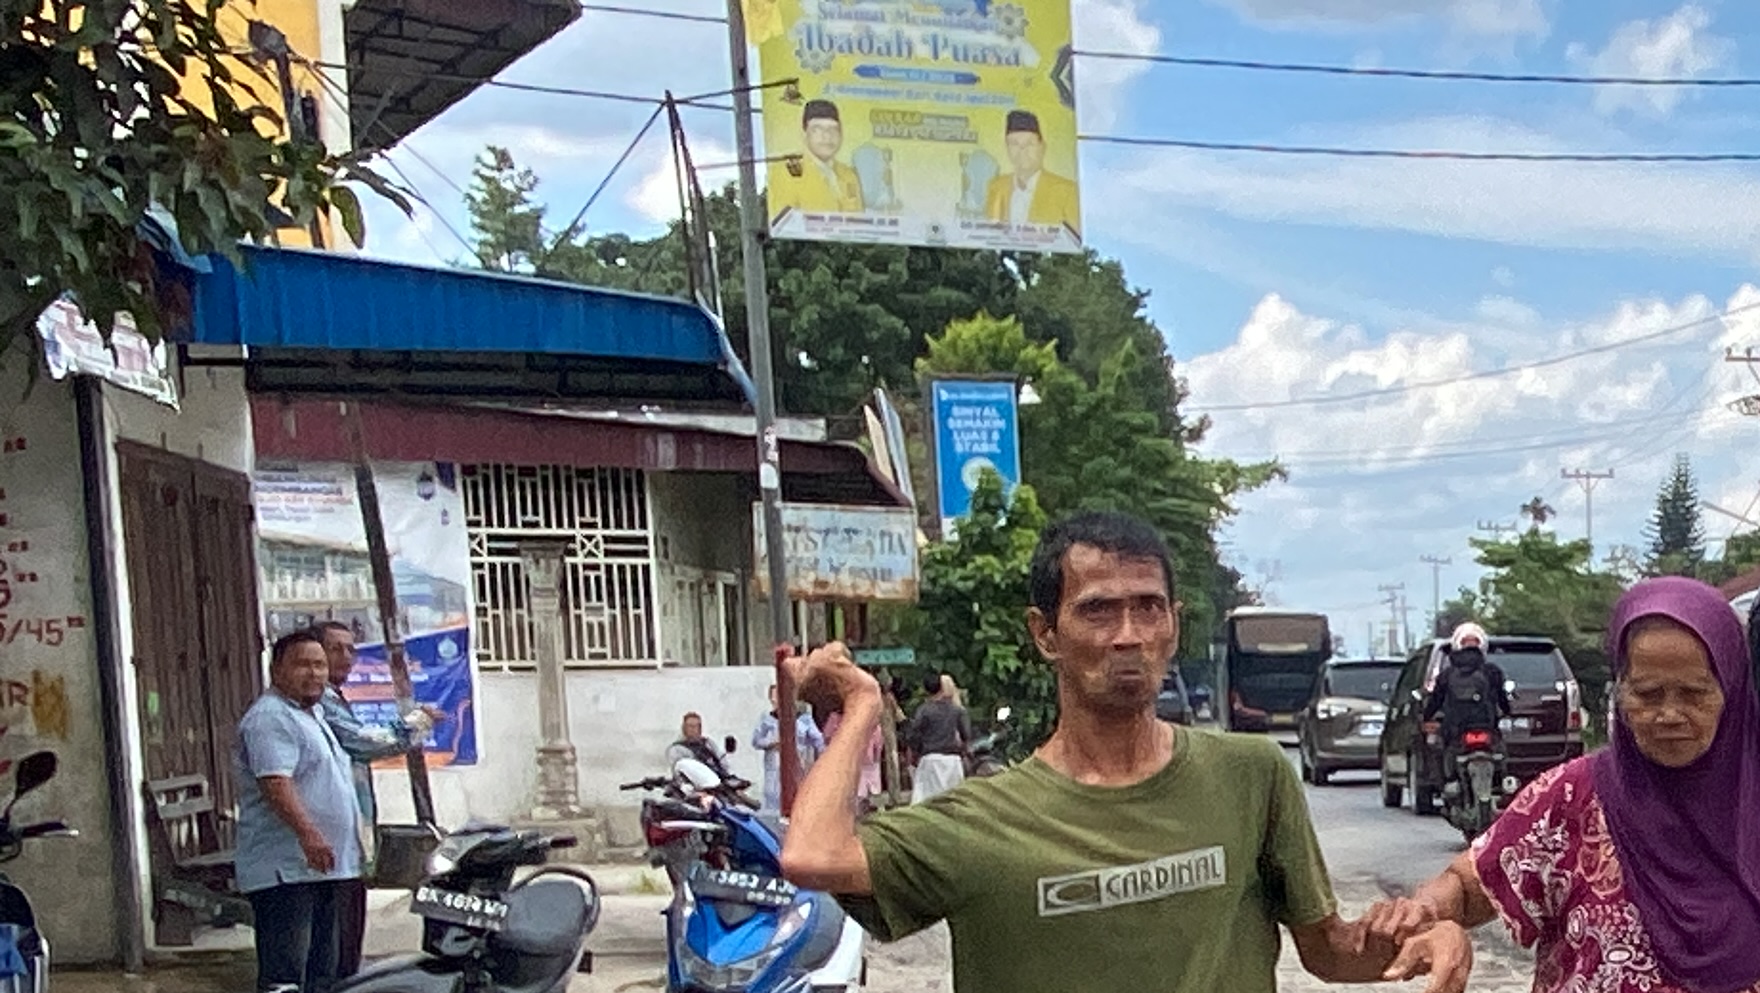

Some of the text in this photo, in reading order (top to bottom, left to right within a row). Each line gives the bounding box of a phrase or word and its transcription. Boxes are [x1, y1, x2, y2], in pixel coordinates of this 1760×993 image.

[797, 23, 1021, 67] Ibadah Puasa
[1106, 852, 1221, 898] CARDINAL
